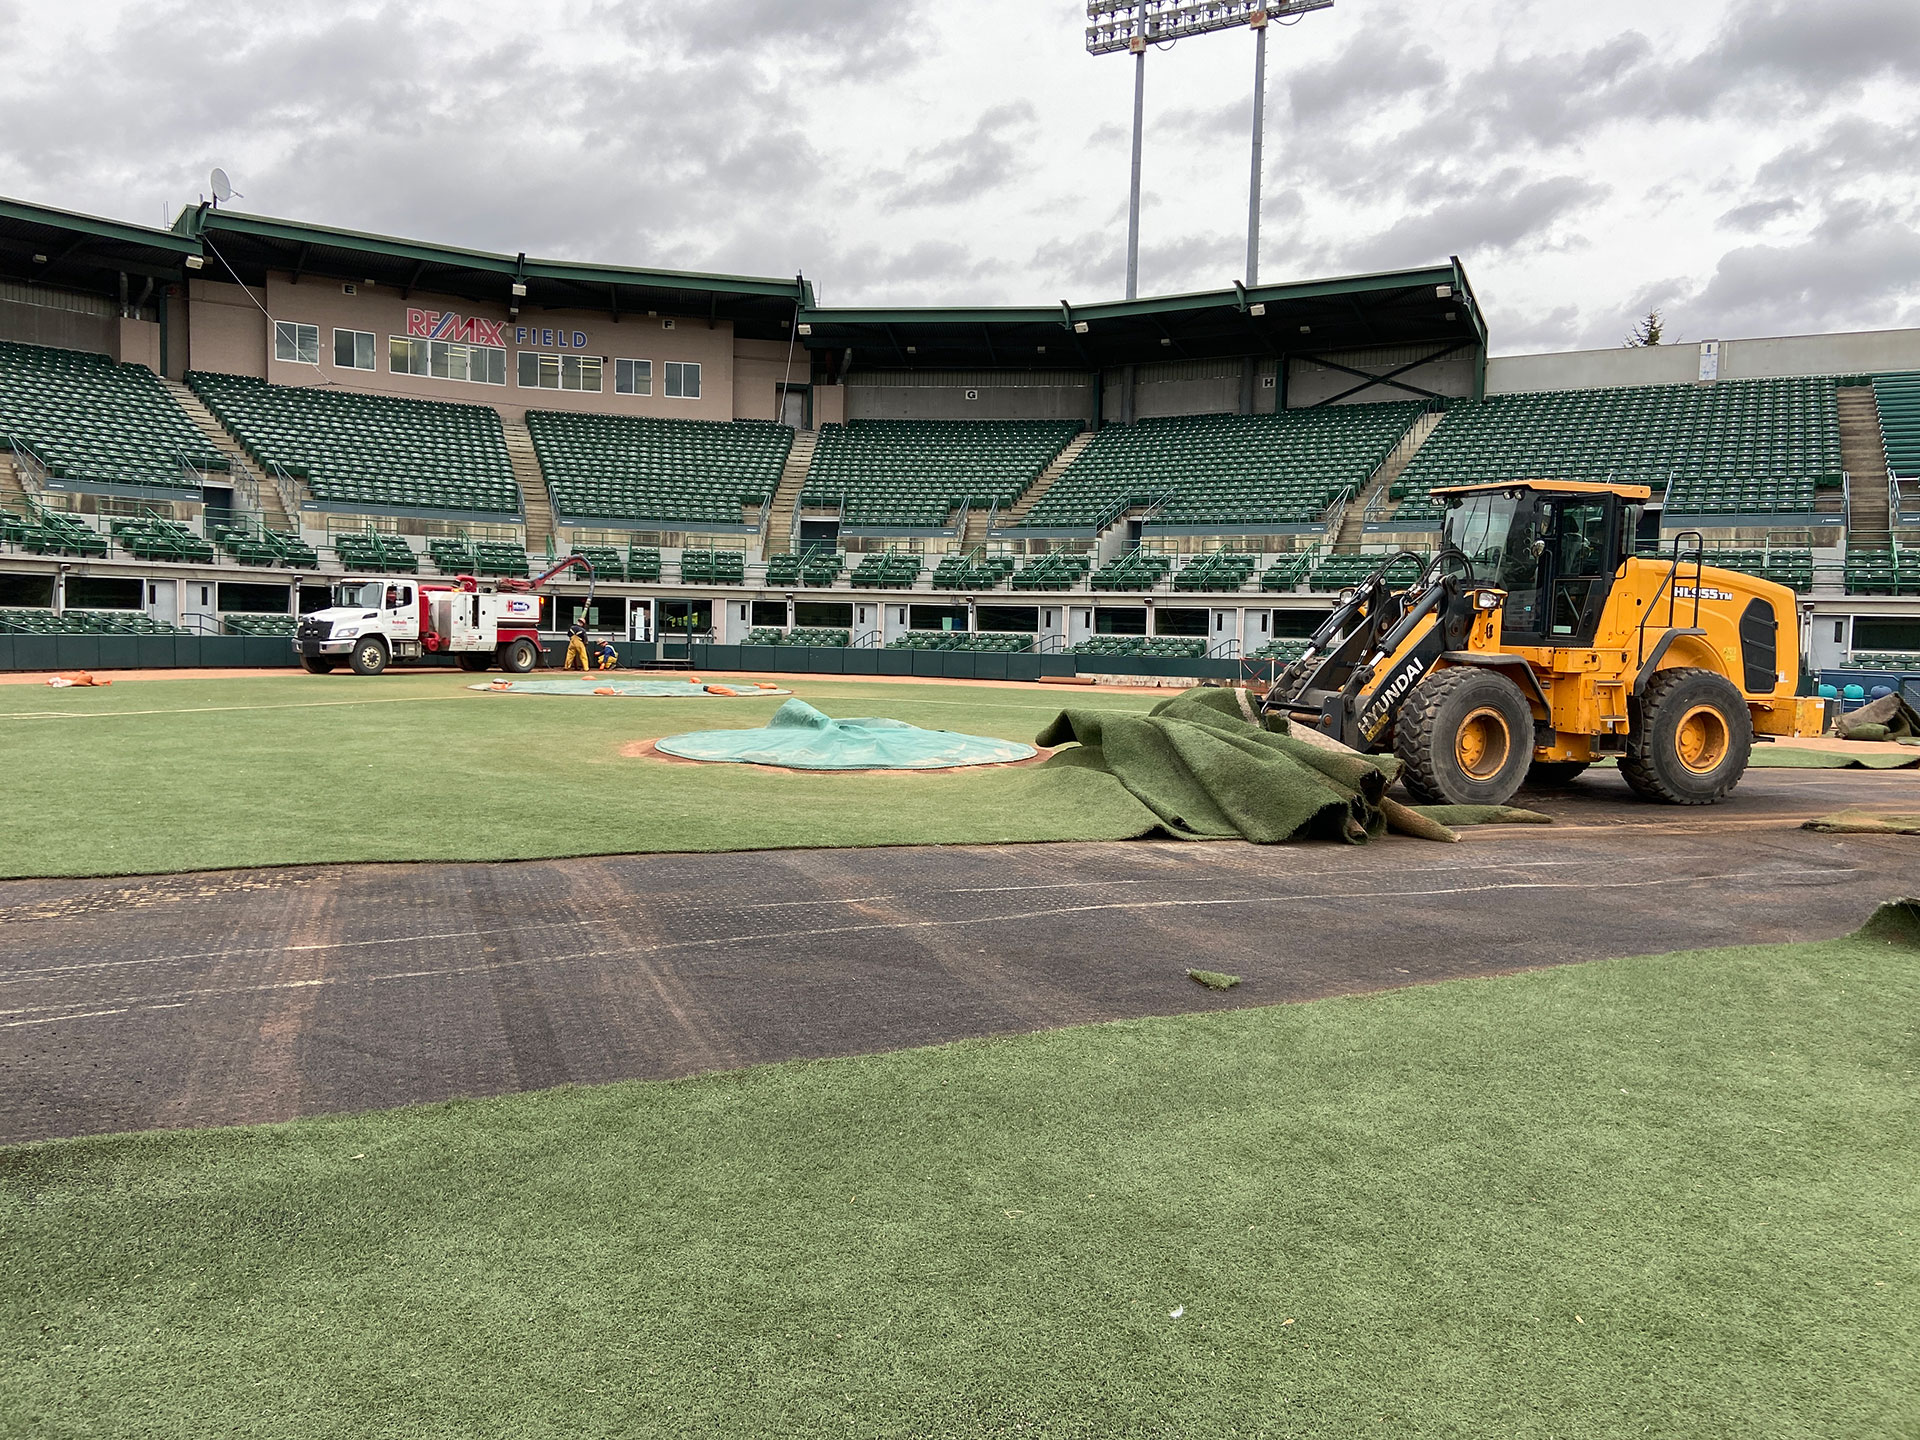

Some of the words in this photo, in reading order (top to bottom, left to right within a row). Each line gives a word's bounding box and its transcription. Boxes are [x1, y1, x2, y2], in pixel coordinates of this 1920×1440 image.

[406, 307, 507, 347] RE/MAX
[516, 326, 588, 349] FIELD
[1357, 656, 1424, 735] HYUNDAI
